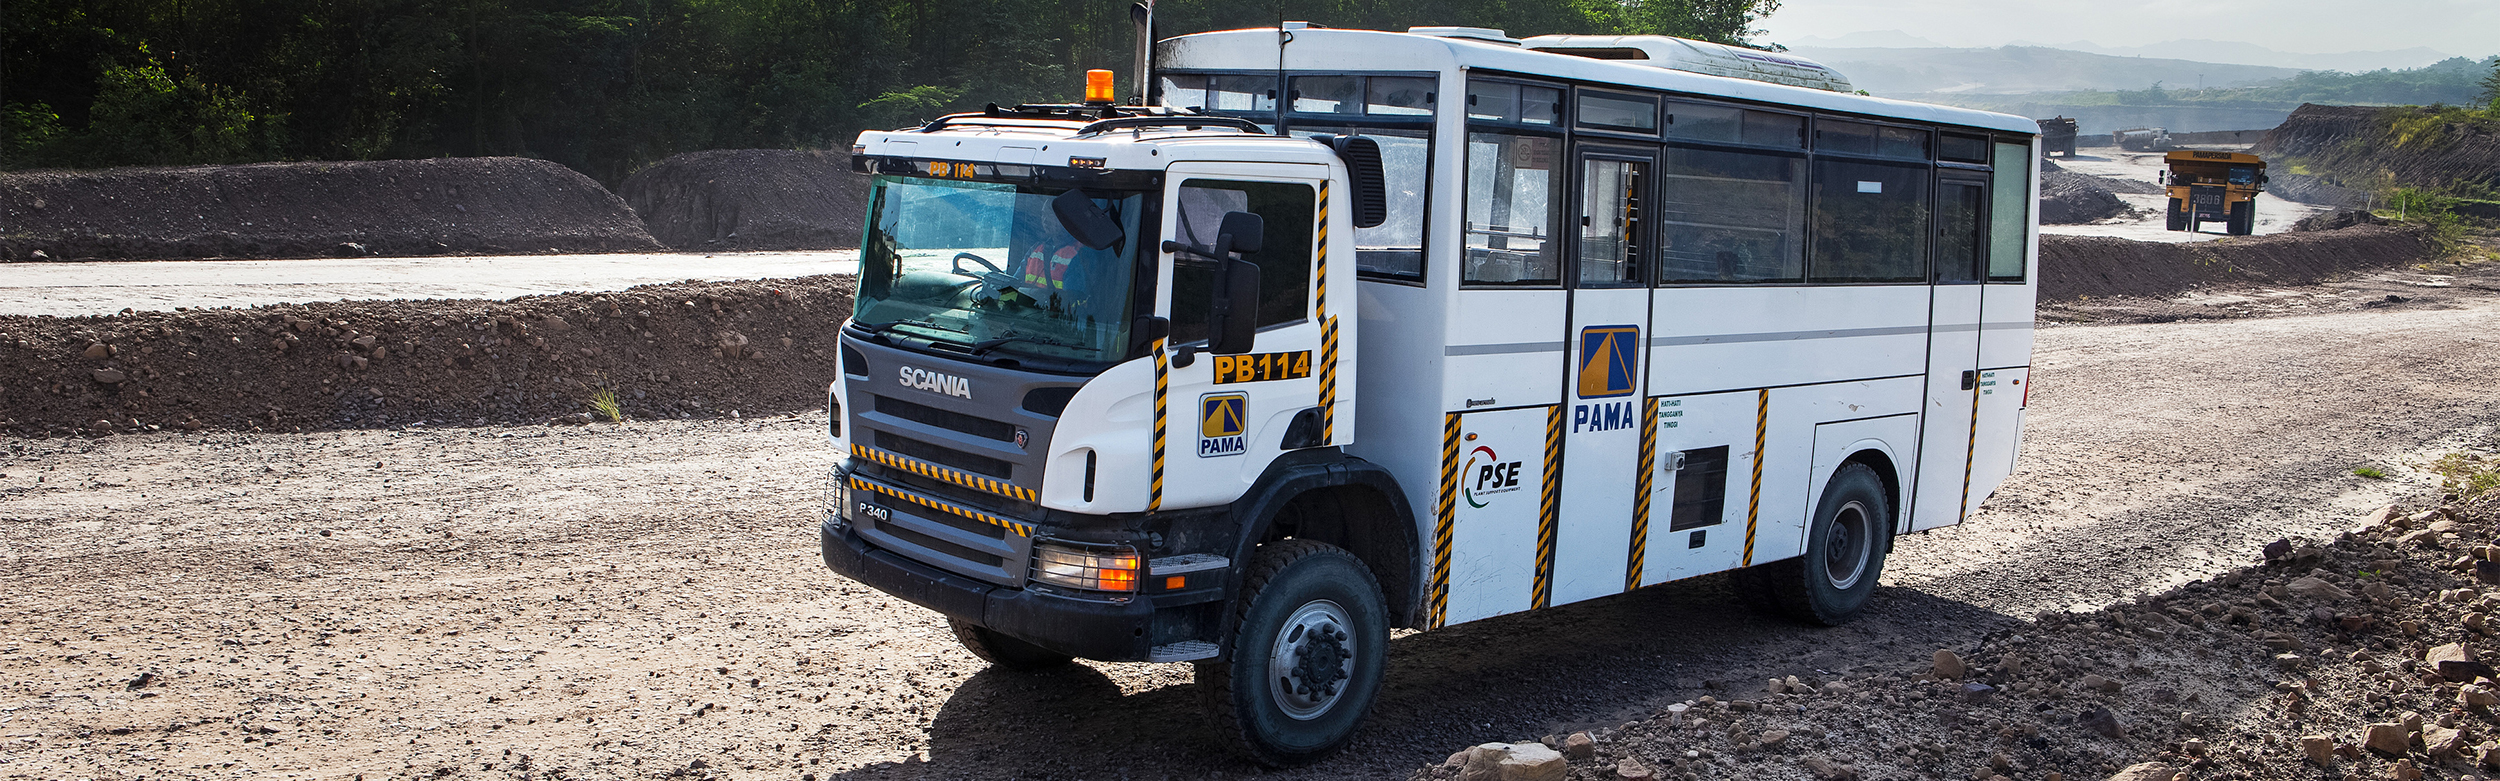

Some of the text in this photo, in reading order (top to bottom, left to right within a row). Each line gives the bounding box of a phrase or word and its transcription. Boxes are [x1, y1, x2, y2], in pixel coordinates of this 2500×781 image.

[929, 161, 975, 179] PB 114
[899, 365, 972, 400] SCANIA
[1573, 401, 1634, 434] PAMA
[1201, 436, 1245, 455] PAMA
[1476, 461, 1522, 491] PSE
[859, 502, 888, 521] P 340
